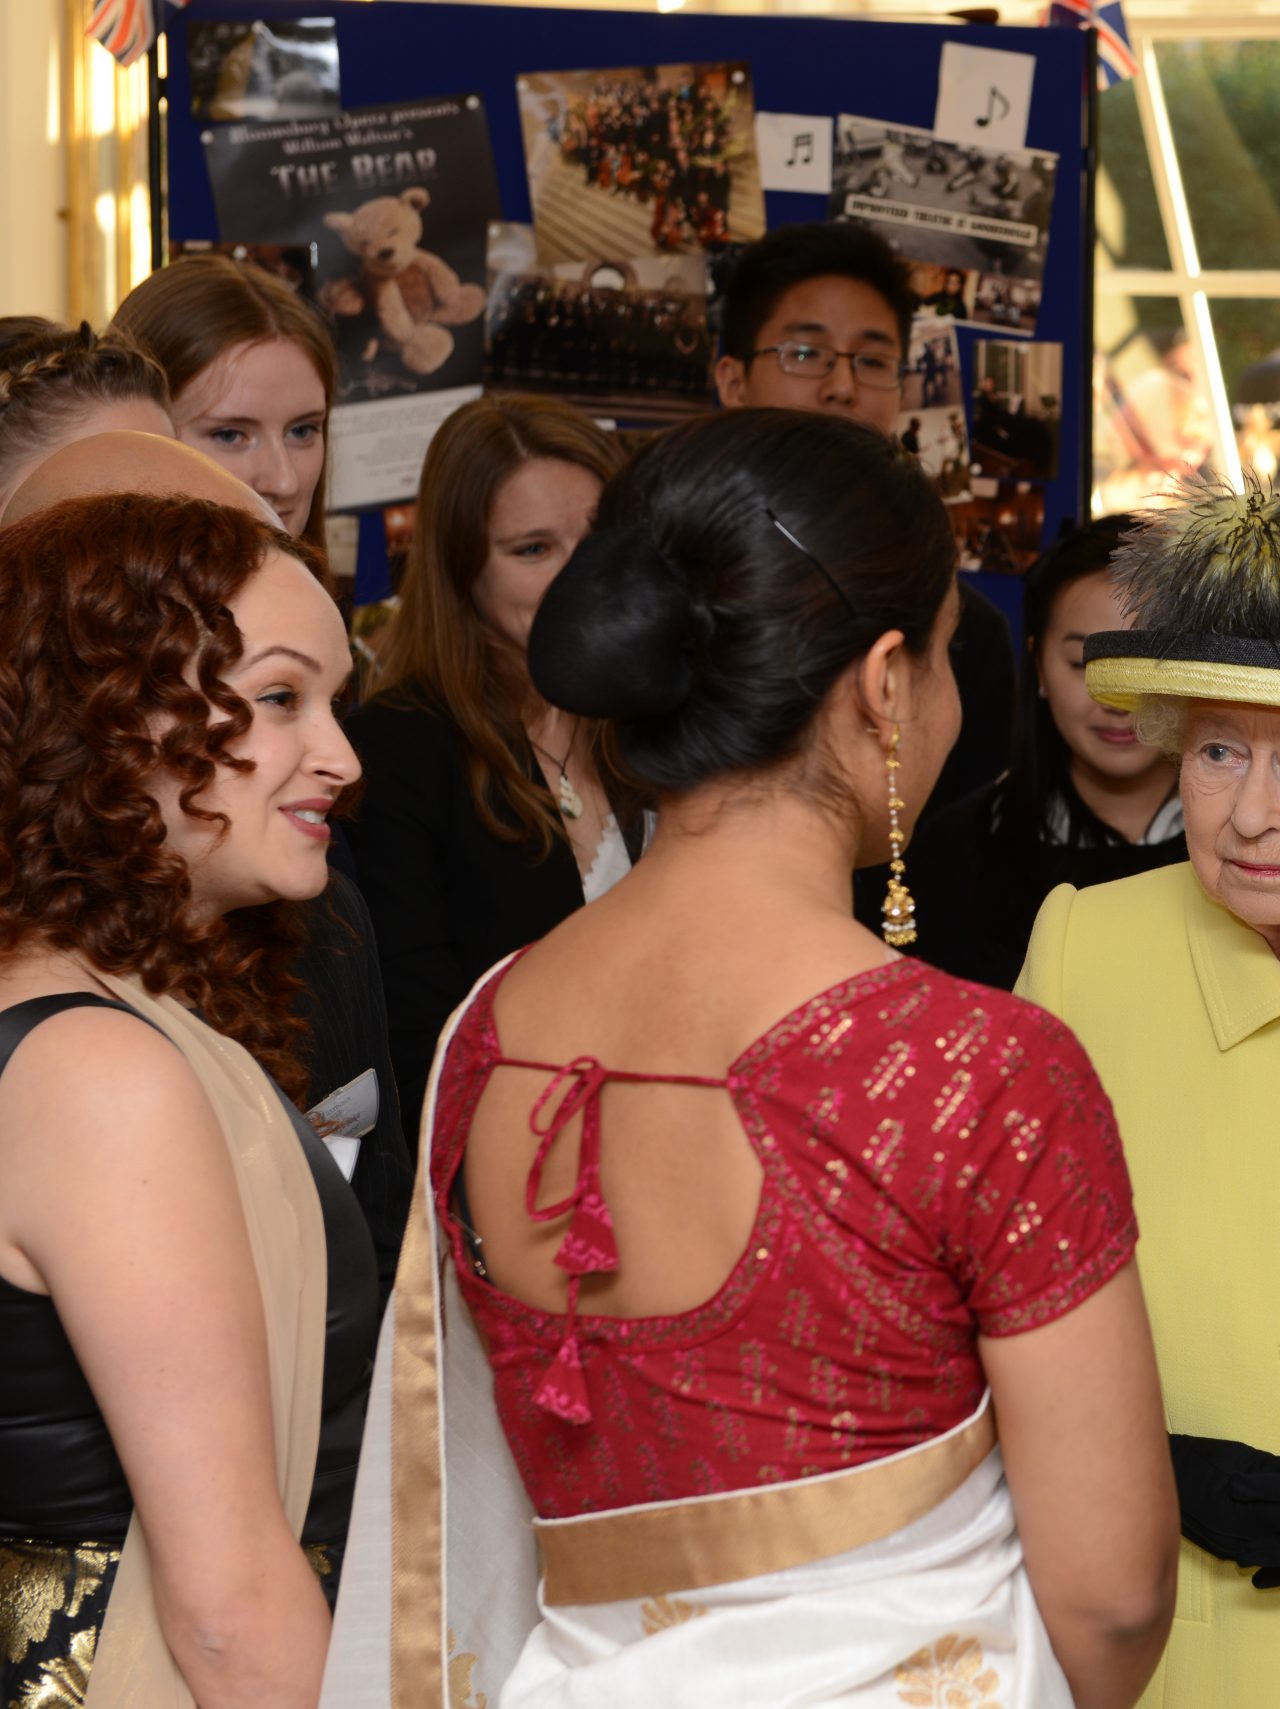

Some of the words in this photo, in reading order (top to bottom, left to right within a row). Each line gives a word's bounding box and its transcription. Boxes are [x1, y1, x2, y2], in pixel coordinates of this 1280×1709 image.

[229, 119, 331, 144] Bloomsbury
[335, 110, 387, 132] Opera
[390, 102, 460, 125] presents
[282, 136, 342, 155] William
[345, 128, 414, 148] Walton's
[269, 160, 337, 199] THE
[350, 147, 439, 190] BEAR
